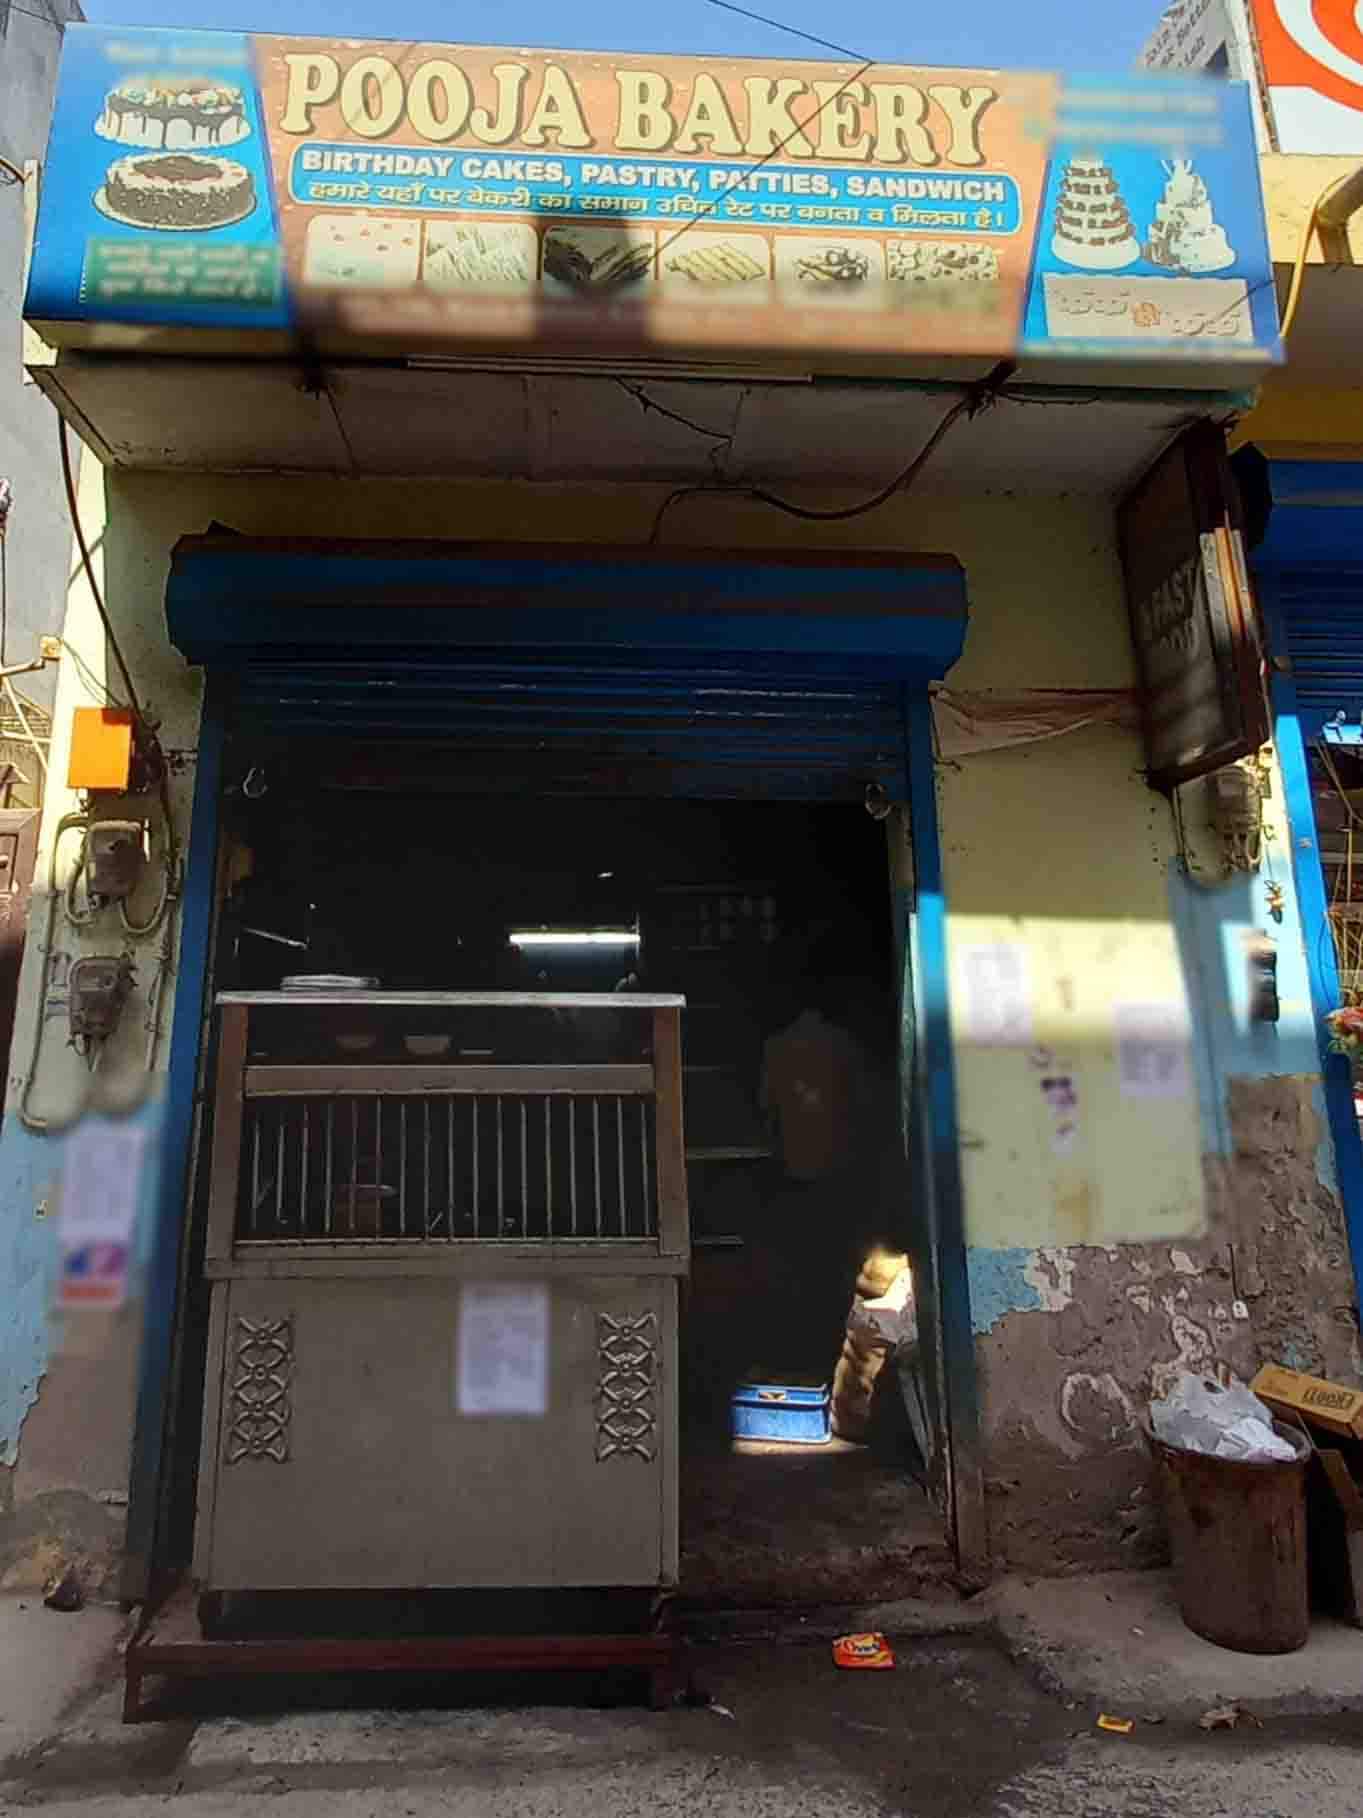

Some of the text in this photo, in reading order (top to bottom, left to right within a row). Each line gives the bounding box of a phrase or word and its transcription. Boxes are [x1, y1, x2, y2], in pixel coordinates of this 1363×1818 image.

[279, 53, 998, 166] POOJA BAKERY
[302, 150, 1005, 202] BIRTHDAY CAKES, PASTRY, PATTIES, SANDWICH
[428, 187, 464, 205] पर
[538, 192, 573, 210] का
[724, 196, 754, 217] रेट
[759, 201, 793, 220] पर
